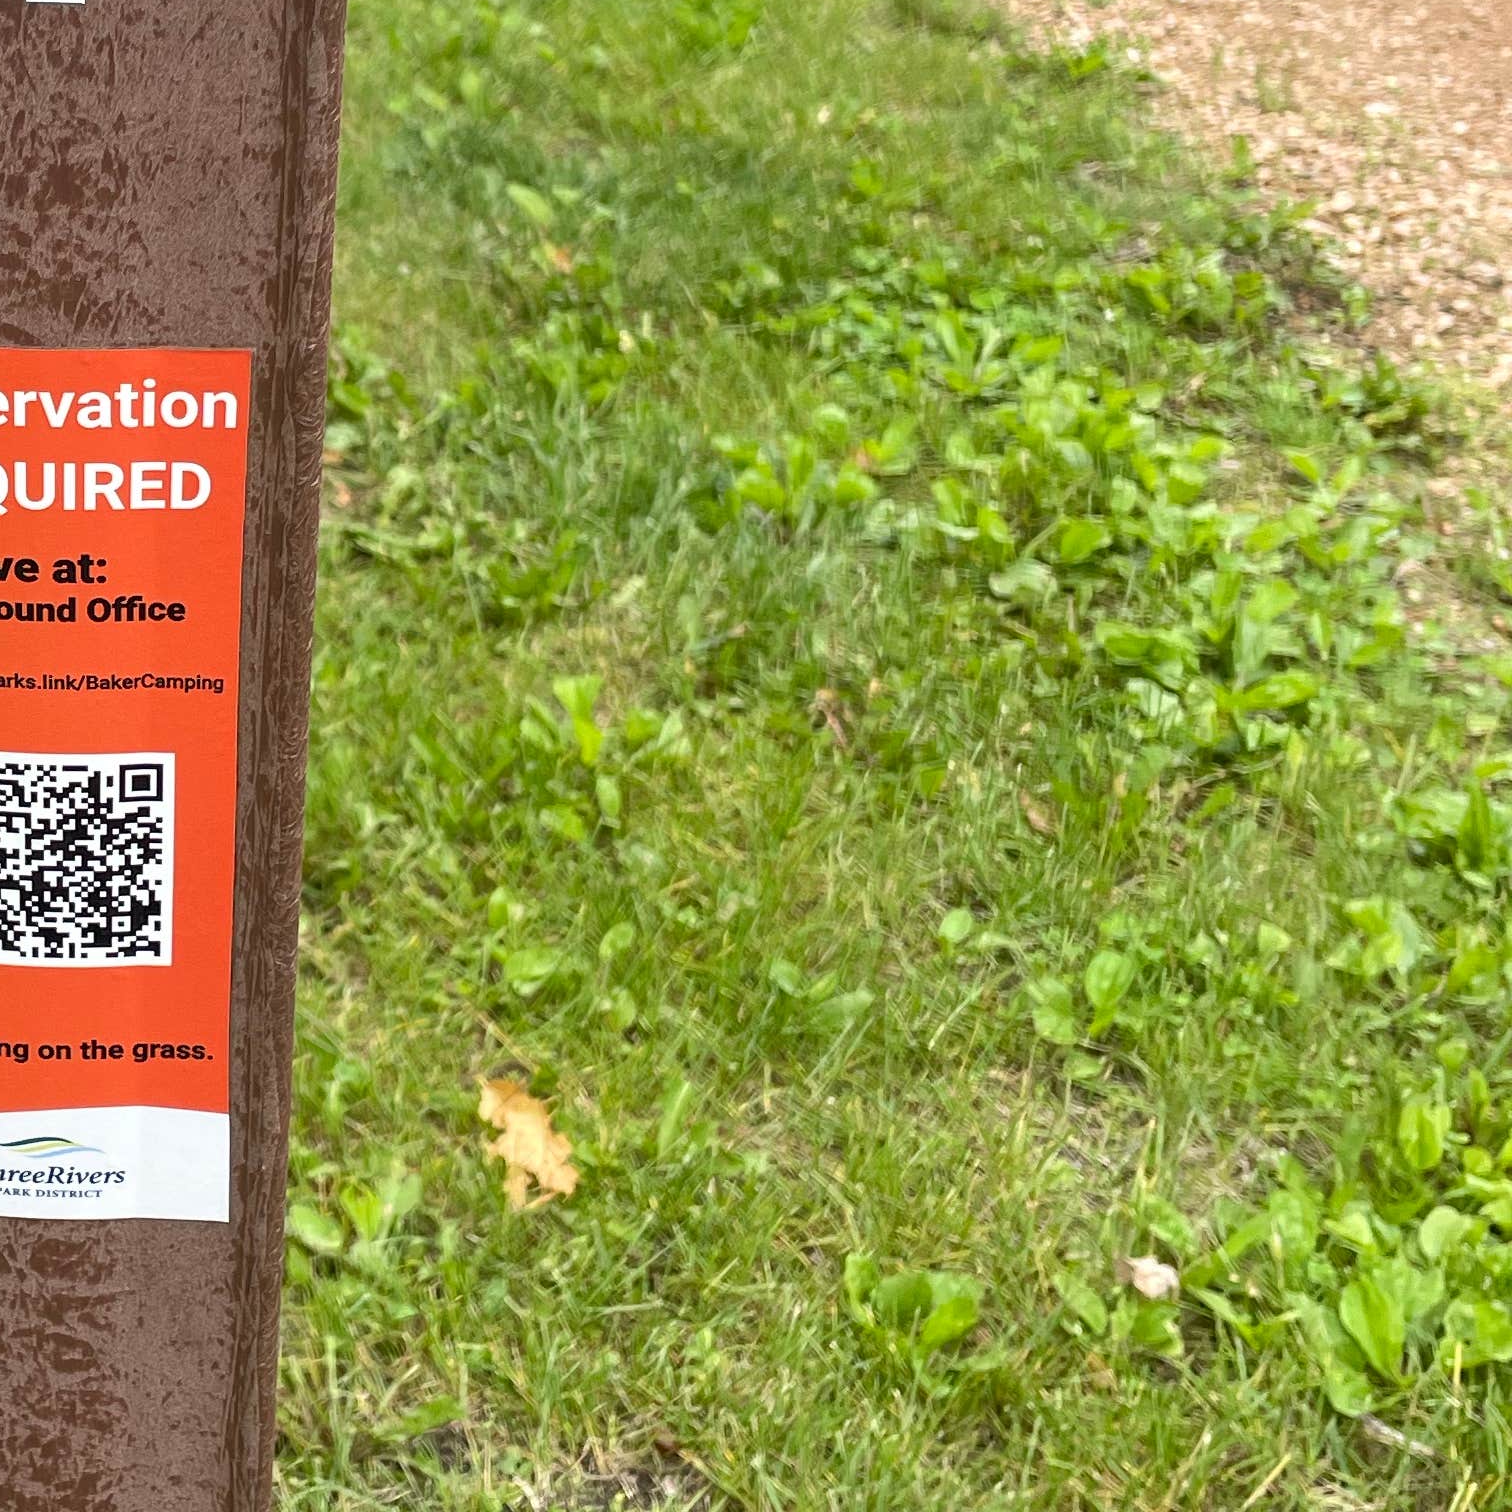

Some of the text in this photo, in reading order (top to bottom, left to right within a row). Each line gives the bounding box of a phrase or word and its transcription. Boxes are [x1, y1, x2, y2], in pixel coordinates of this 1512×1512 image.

[52, 554, 108, 584] at:
[87, 595, 186, 623] Office
[38, 1041, 72, 1060] on
[80, 1040, 124, 1060] the
[132, 1042, 214, 1063] grass.
[35, 1188, 104, 1199] DISTRICT
